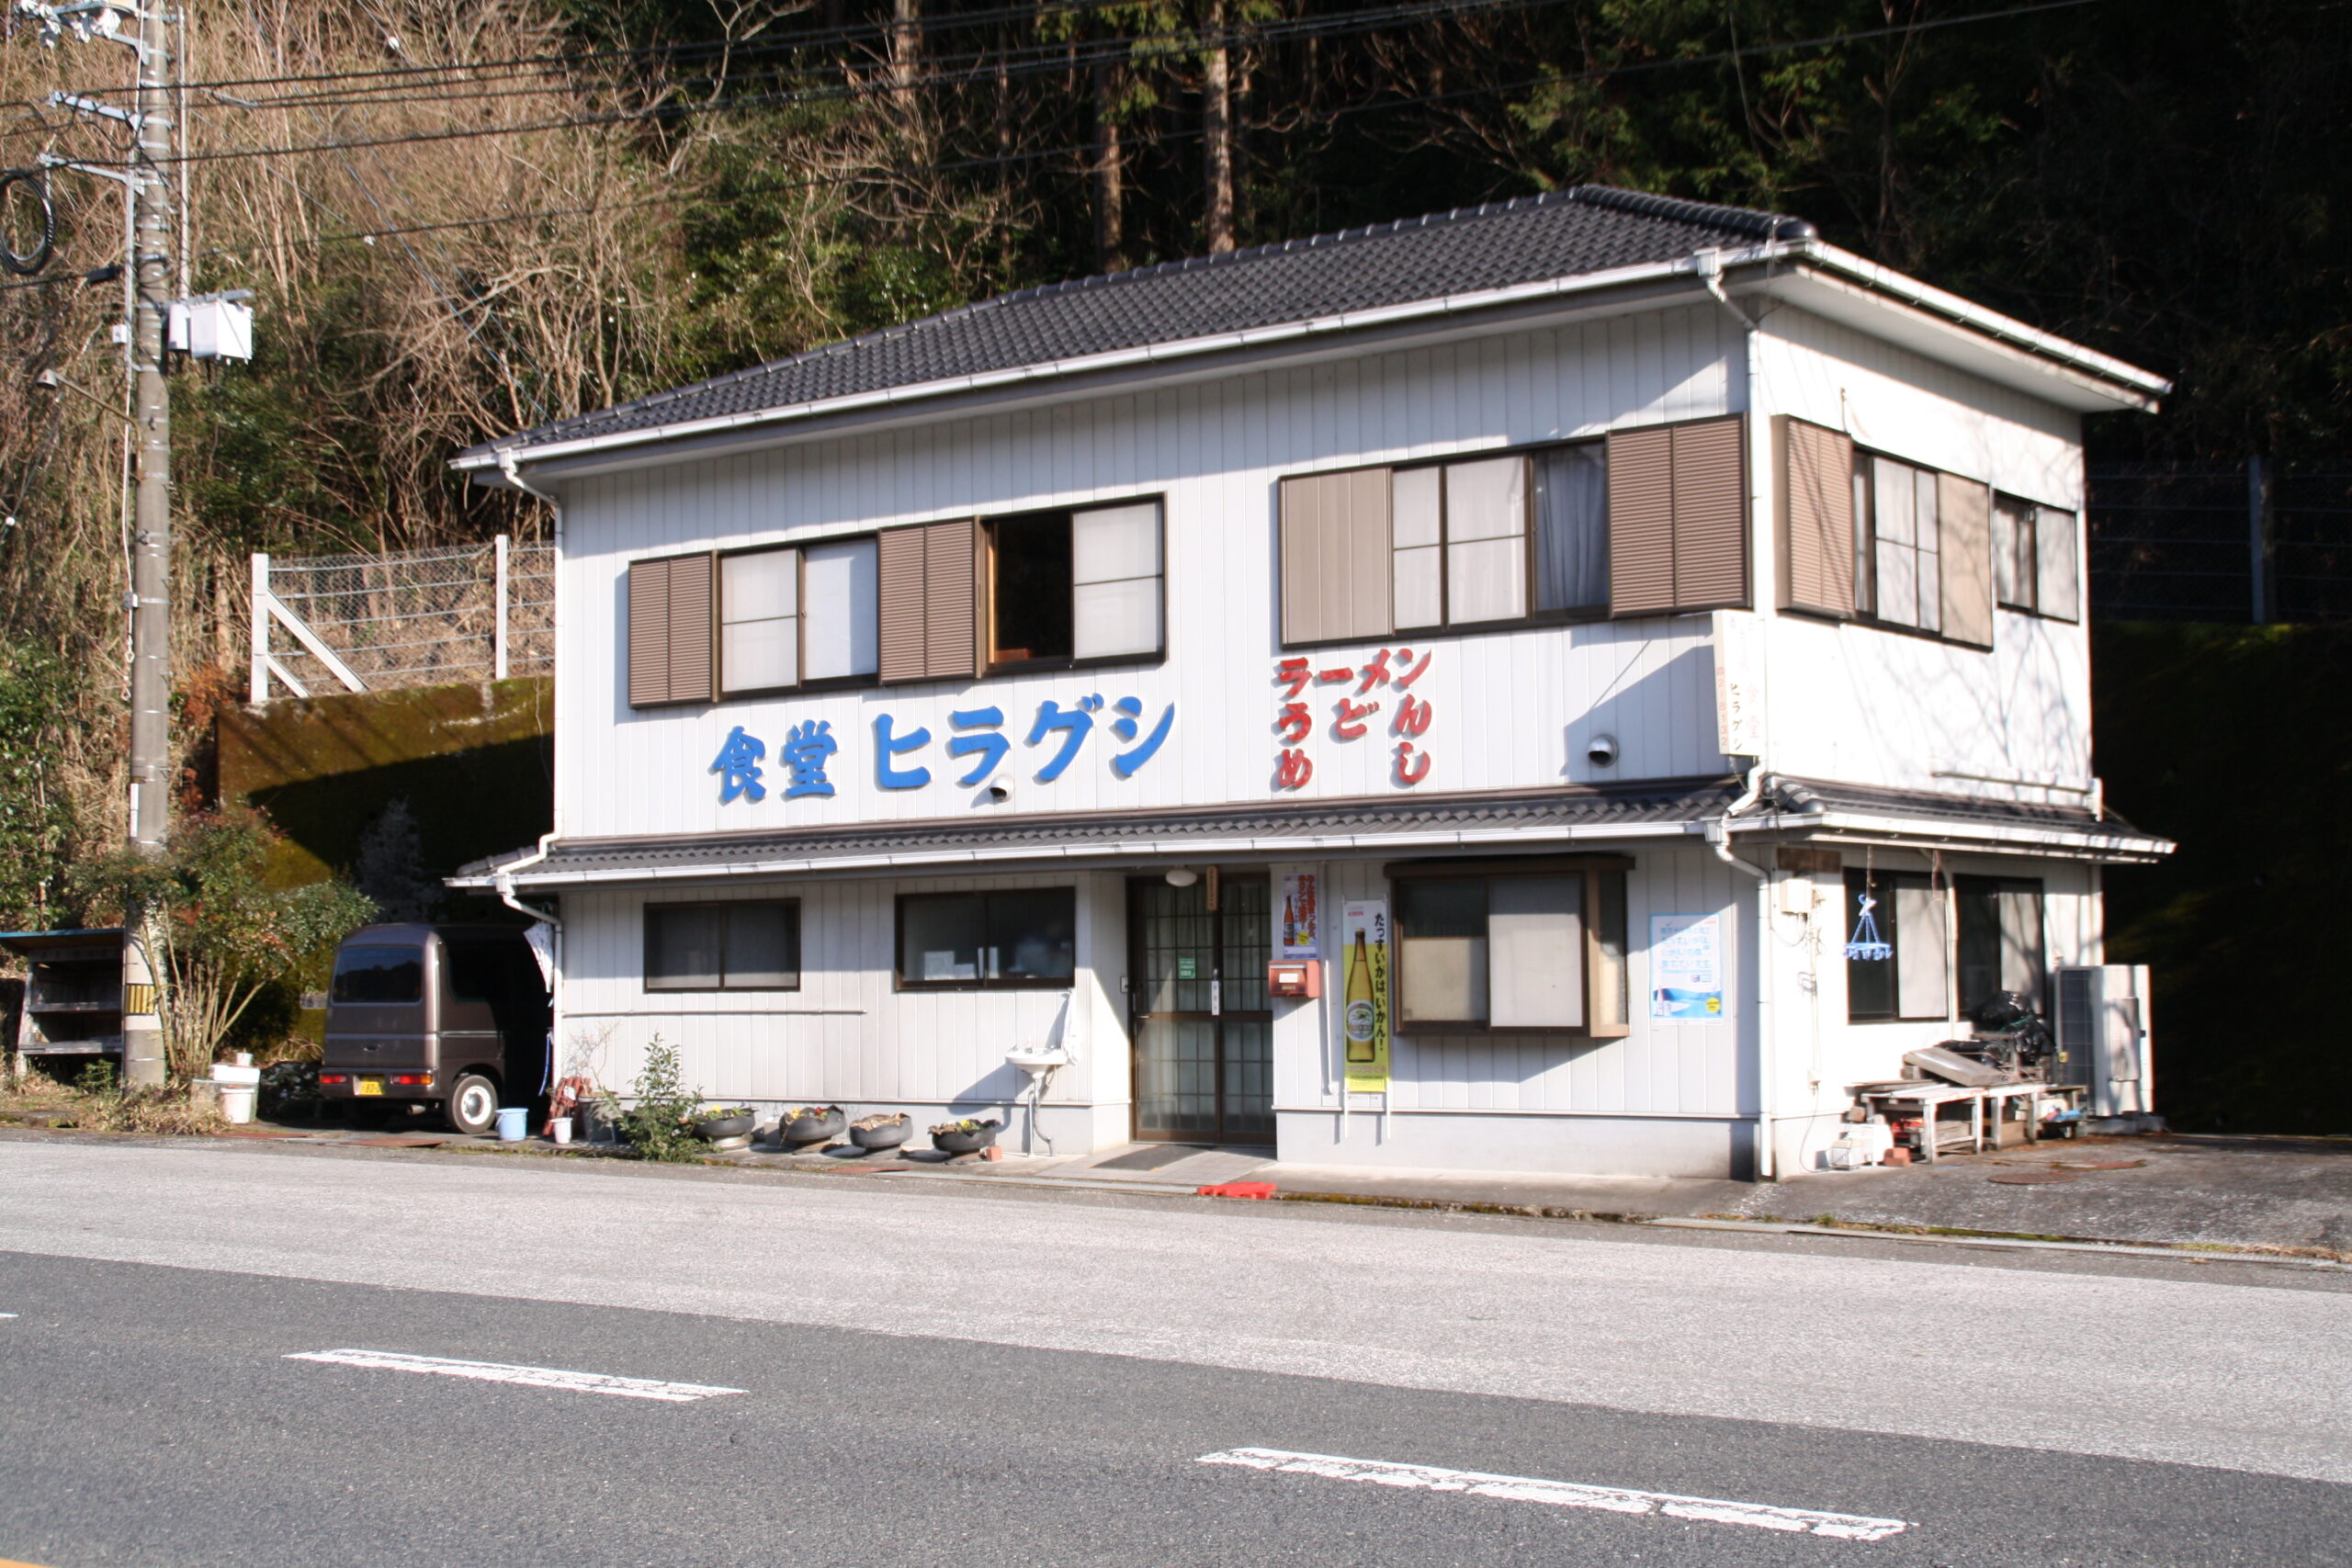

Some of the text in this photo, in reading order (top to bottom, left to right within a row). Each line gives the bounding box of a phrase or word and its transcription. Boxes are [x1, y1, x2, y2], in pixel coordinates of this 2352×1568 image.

[1278, 649, 1431, 697] ラーメン
[1278, 694, 1432, 742] うどん
[712, 694, 1174, 802] 食堂 ヒラグシ
[1278, 742, 1430, 787] めし
